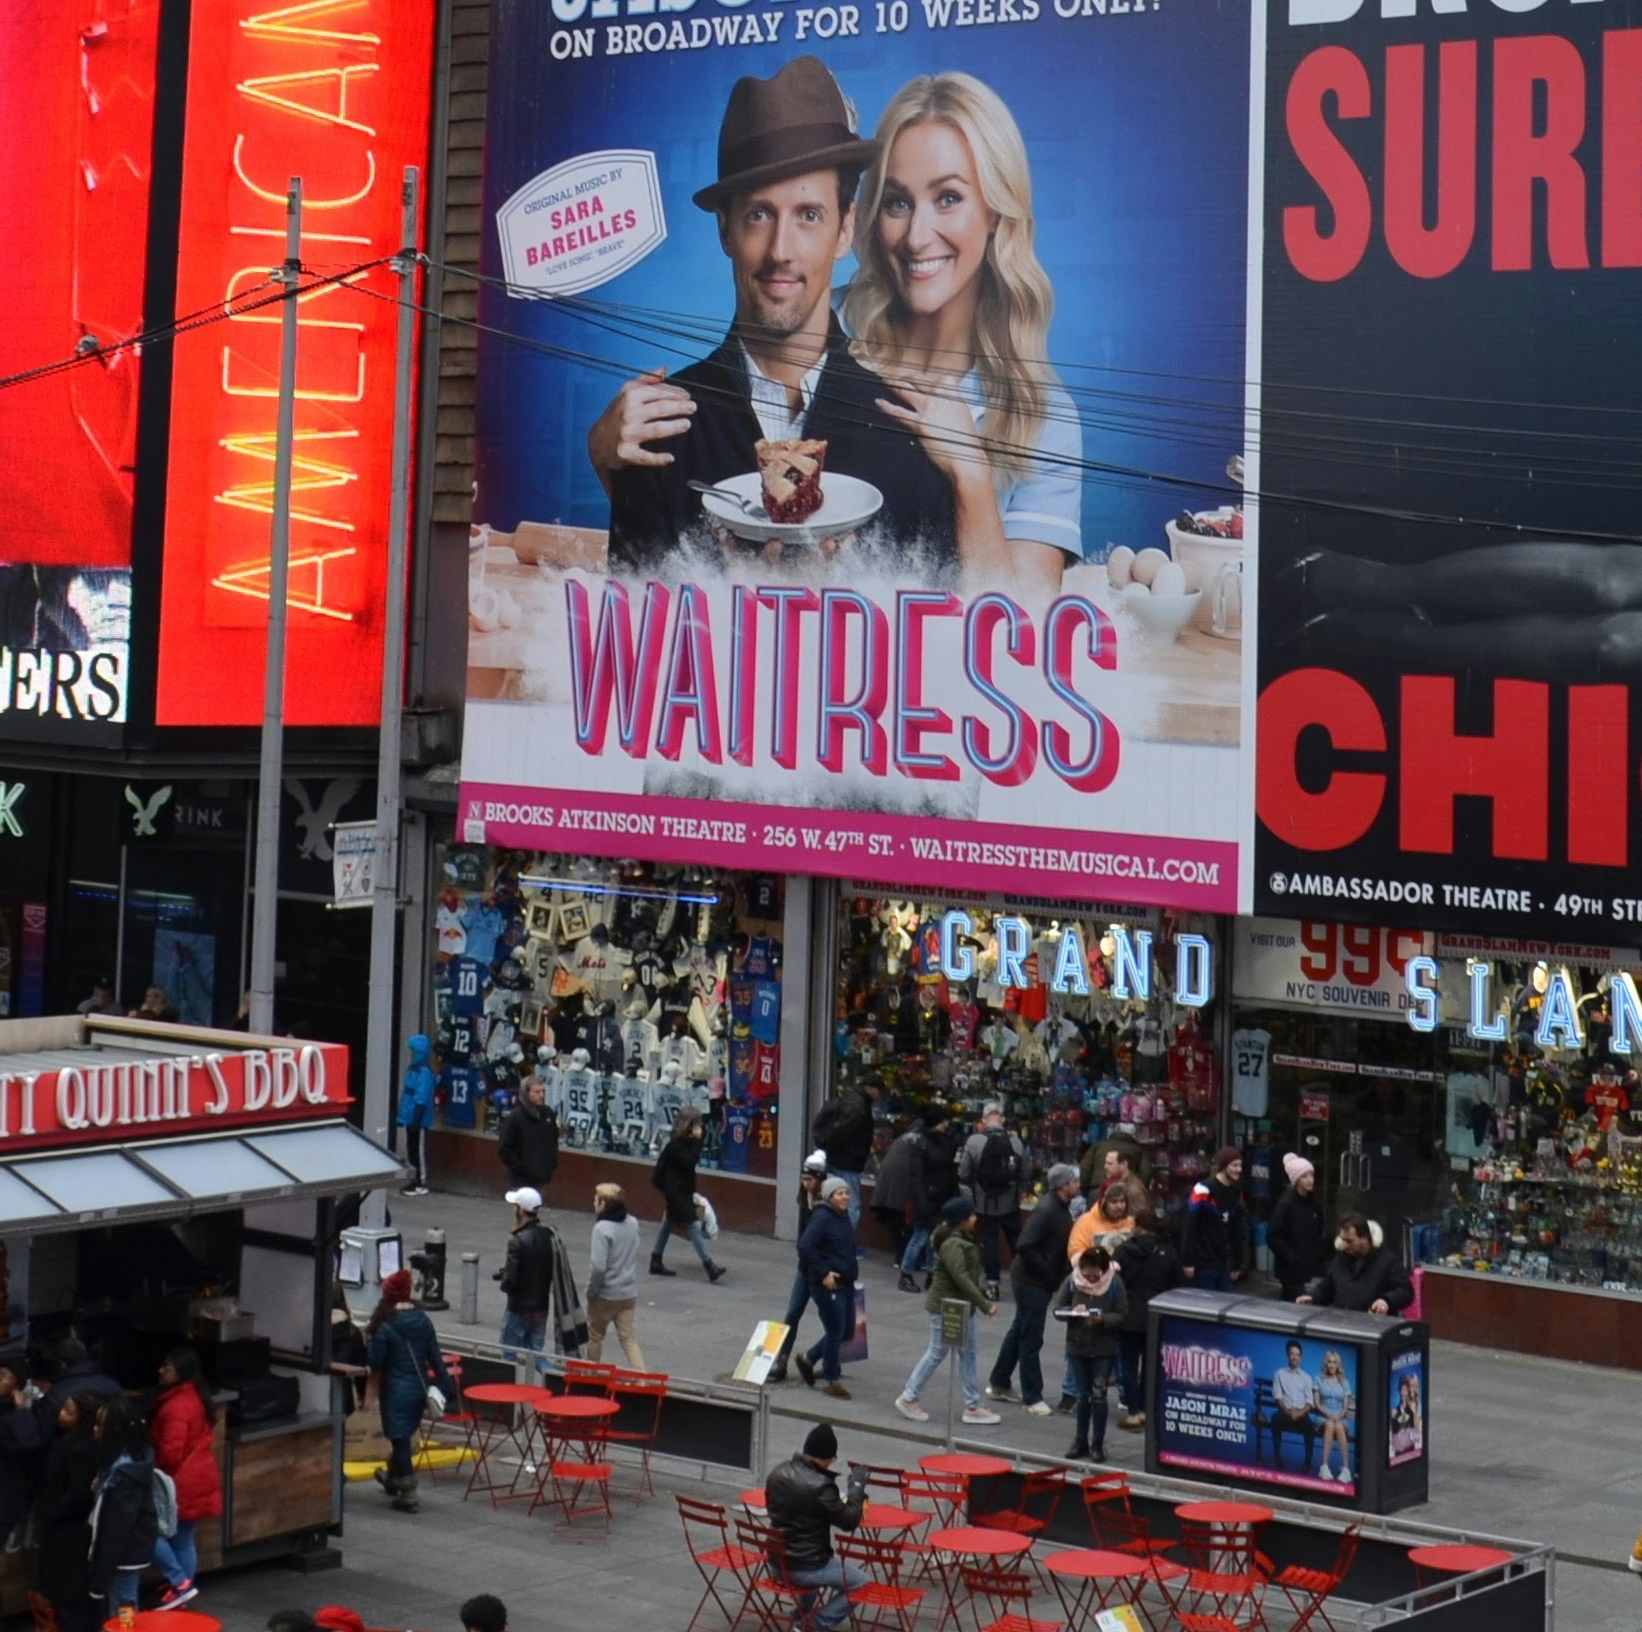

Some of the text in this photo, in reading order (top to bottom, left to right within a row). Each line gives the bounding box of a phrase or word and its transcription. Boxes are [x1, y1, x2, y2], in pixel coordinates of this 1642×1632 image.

[550, 33, 596, 60] ON
[606, 12, 785, 55] BROADWAY
[796, 4, 858, 39] FOR
[875, 2, 908, 33] 10
[524, 168, 624, 215] ORIGINAL MUSIC BY
[550, 195, 604, 230] SARA
[525, 209, 637, 267] BAREILLES
[563, 579, 1121, 793] WAITRESS
[485, 802, 1220, 885] BROOKS ATKINSON THEATRE 256 W. 47TH ST. WAITRESSTHEMUSICAL.COM
[1289, 872, 1433, 905] AMBASSADOR
[1442, 884, 1531, 913] THEATRE
[1554, 894, 1603, 916] 49TH
[1250, 932, 1275, 945] VISIT
[1276, 935, 1296, 948] OUR
[942, 909, 1210, 1008] GRAND
[458, 970, 478, 997] 10
[1286, 981, 1391, 1009] NYC SOUVENIR
[453, 1028, 471, 1054] 12
[1237, 1052, 1264, 1078] 27
[57, 1053, 230, 1129] QUINN'S
[243, 1045, 329, 1111] BBQ
[451, 1078, 469, 1105] 13
[623, 1100, 645, 1121] 24
[1162, 1342, 1253, 1389] WAITRESS
[1165, 1395, 1207, 1416] JASON
[1209, 1403, 1246, 1419] MRAZ
[1180, 1411, 1226, 1429] BROADWAY
[1229, 1420, 1246, 1432] FOR
[1165, 1421, 1246, 1444] 10 WEEKS ONLY!
